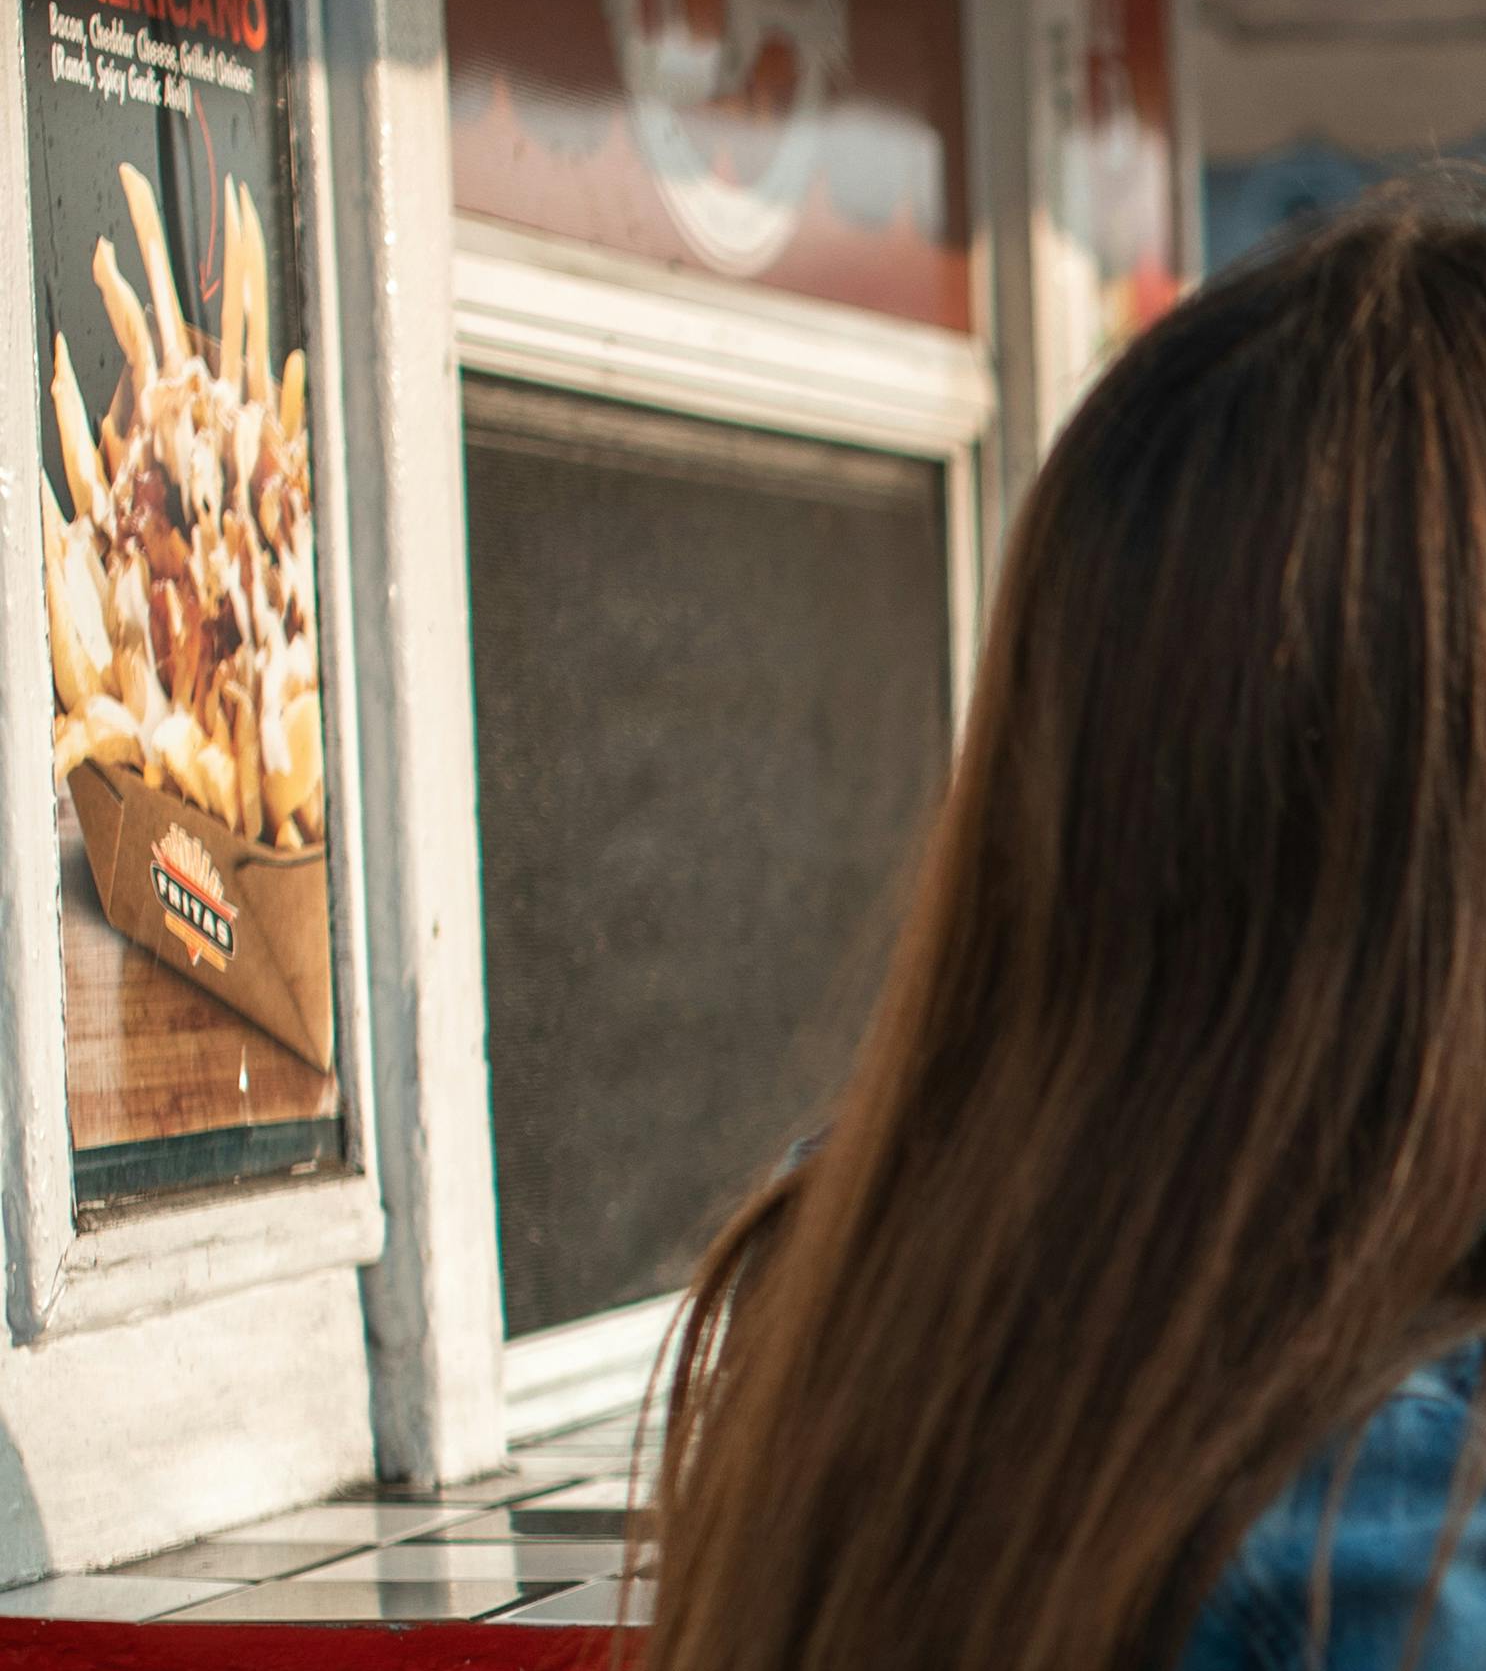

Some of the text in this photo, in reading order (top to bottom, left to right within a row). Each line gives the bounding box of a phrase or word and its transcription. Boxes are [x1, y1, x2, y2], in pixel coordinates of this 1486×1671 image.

[89, 13, 135, 59] Cheddar
[96, 54, 126, 105] Spicy
[157, 870, 230, 947] FRITAS
